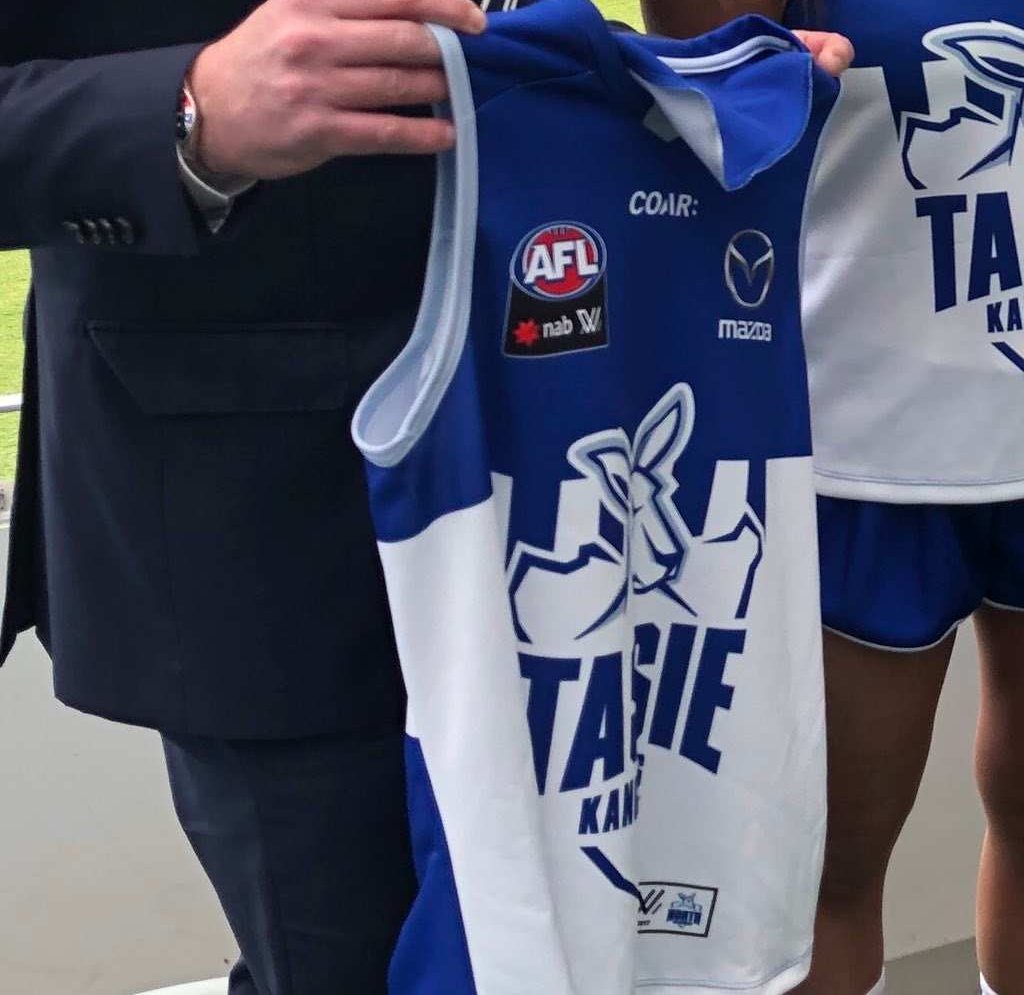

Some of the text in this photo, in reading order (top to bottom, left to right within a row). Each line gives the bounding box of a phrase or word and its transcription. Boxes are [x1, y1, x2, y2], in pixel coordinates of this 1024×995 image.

[524, 238, 599, 285] AFL
[542, 315, 574, 339] nab
[718, 318, 773, 342] mazda
[516, 621, 748, 797] TASIE
